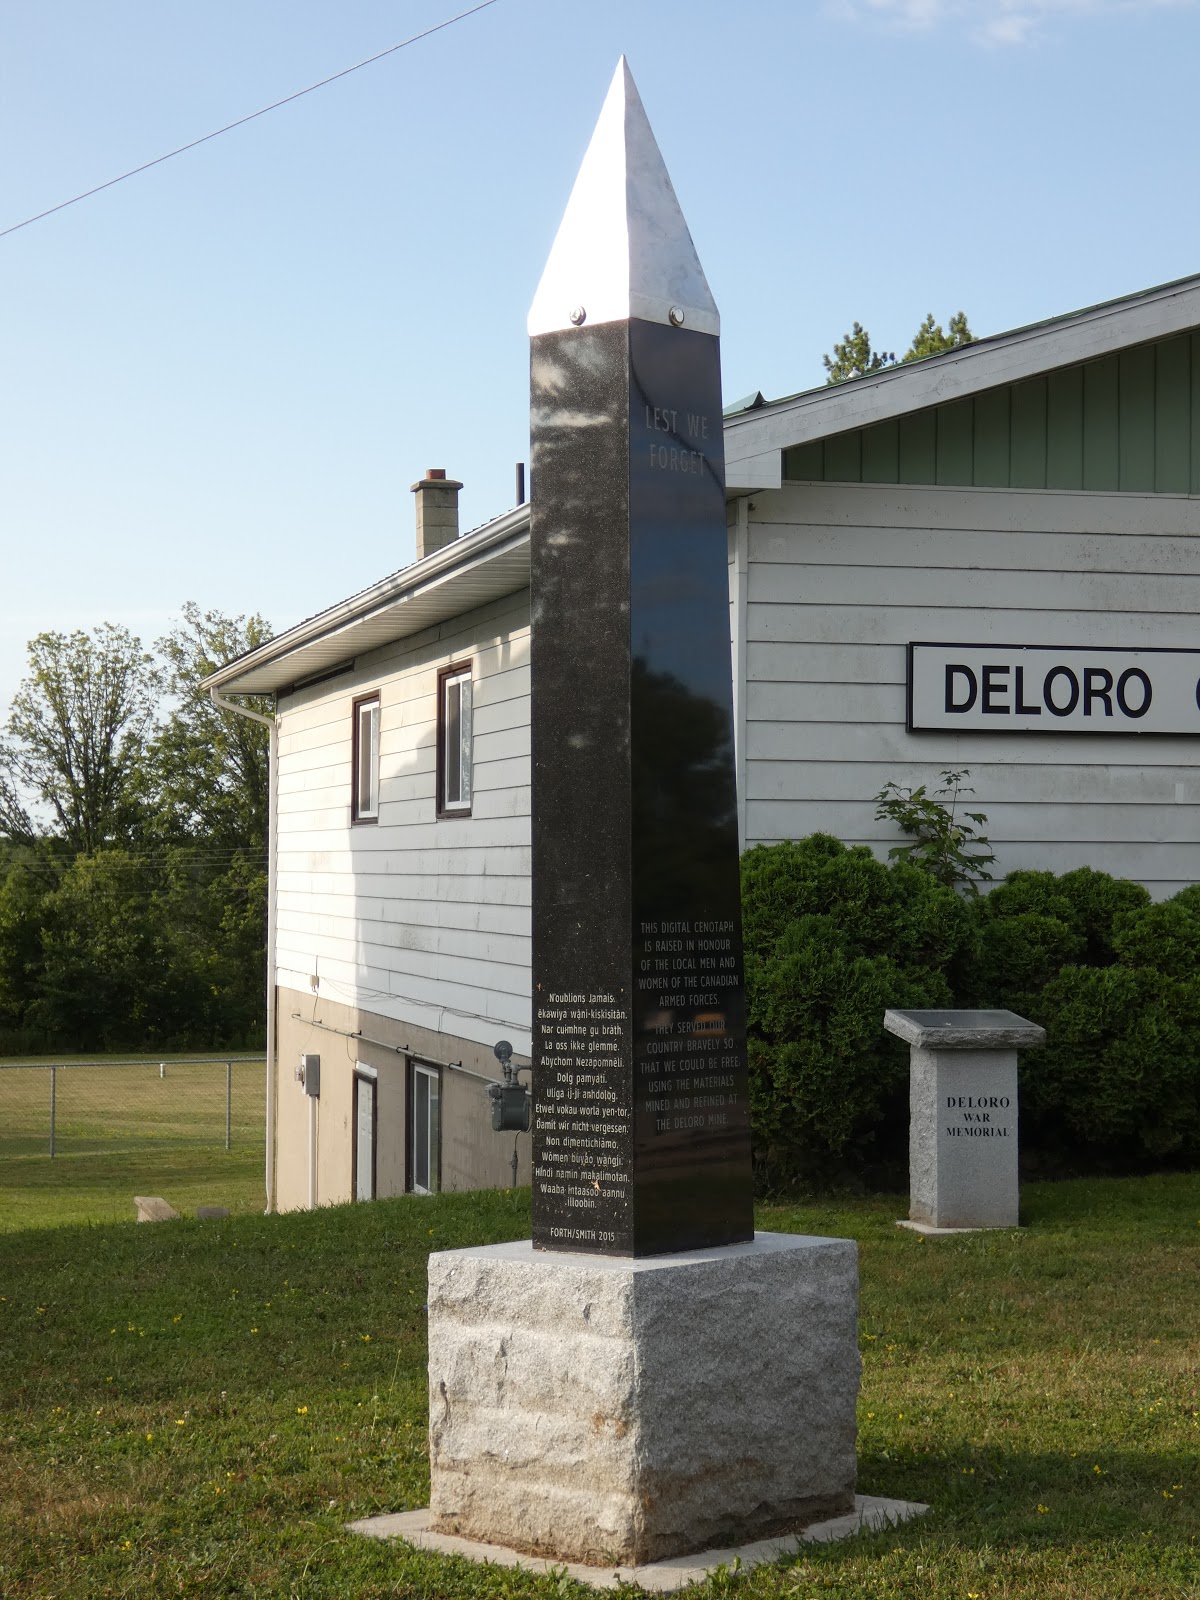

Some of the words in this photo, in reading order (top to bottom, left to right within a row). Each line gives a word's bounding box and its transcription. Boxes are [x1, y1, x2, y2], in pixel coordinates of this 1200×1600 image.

[645, 405, 677, 433] LEST
[687, 414, 708, 440] WE
[650, 443, 705, 476] FORGET
[945, 664, 1152, 719] DELORO
[640, 922, 658, 933] THIS
[661, 922, 690, 933] DIGITAL
[694, 921, 734, 933] CENOTAPH
[644, 941, 652, 952] IS
[655, 940, 682, 951] RAISED
[686, 940, 695, 951] IN
[698, 939, 731, 951] HONOUR
[640, 959, 651, 971] OF
[655, 959, 669, 970] THE
[672, 958, 696, 970] LOCAL
[700, 957, 716, 969] MEN
[720, 956, 735, 968] AND
[639, 977, 668, 990] WOMEN
[671, 977, 681, 988] OF
[684, 976, 697, 987] THE
[700, 975, 739, 987] CANADIAN
[549, 993, 586, 1003] N'oublions
[659, 995, 685, 1007] ARMED
[689, 993, 720, 1006] FORCES.
[541, 1025, 554, 1034] Nar
[590, 1027, 599, 1037] gu
[655, 1023, 674, 1035] THEY
[677, 1021, 706, 1034] SERVED
[709, 1020, 726, 1031] OUR
[555, 1042, 568, 1051] oss
[570, 1040, 585, 1051] ikke
[647, 1040, 683, 1054] COUNTRY
[687, 1038, 720, 1052] BRAVELY
[723, 1038, 734, 1049] SO
[540, 1056, 573, 1068] Abychom
[640, 1061, 660, 1074] THAT
[664, 1060, 676, 1072] WE
[680, 1059, 705, 1071] COULD
[709, 1057, 718, 1069] BE
[557, 1073, 573, 1085] Dolg
[648, 1080, 672, 1092] USING
[676, 1079, 690, 1090] THE
[693, 1075, 734, 1088] MATERIALS
[645, 1099, 670, 1112] MINED
[673, 1097, 690, 1109] AND
[694, 1095, 725, 1108] REFINED
[728, 1094, 738, 1105] AT
[947, 1096, 1010, 1109] DELORO
[656, 1119, 671, 1131] THE
[675, 1115, 704, 1128] DELORO
[963, 1113, 990, 1123] WAR
[536, 1119, 556, 1130] Damit
[558, 1120, 570, 1130] wir
[572, 1121, 589, 1131] nicht
[591, 1124, 629, 1135] vergessen.
[947, 1127, 1010, 1137] MEMORIAL
[546, 1136, 560, 1146] Non
[535, 1168, 553, 1178] Hindi
[556, 1169, 578, 1179] namin
[550, 1227, 596, 1240] FORTH/SMITH
[599, 1231, 615, 1241] 2015
